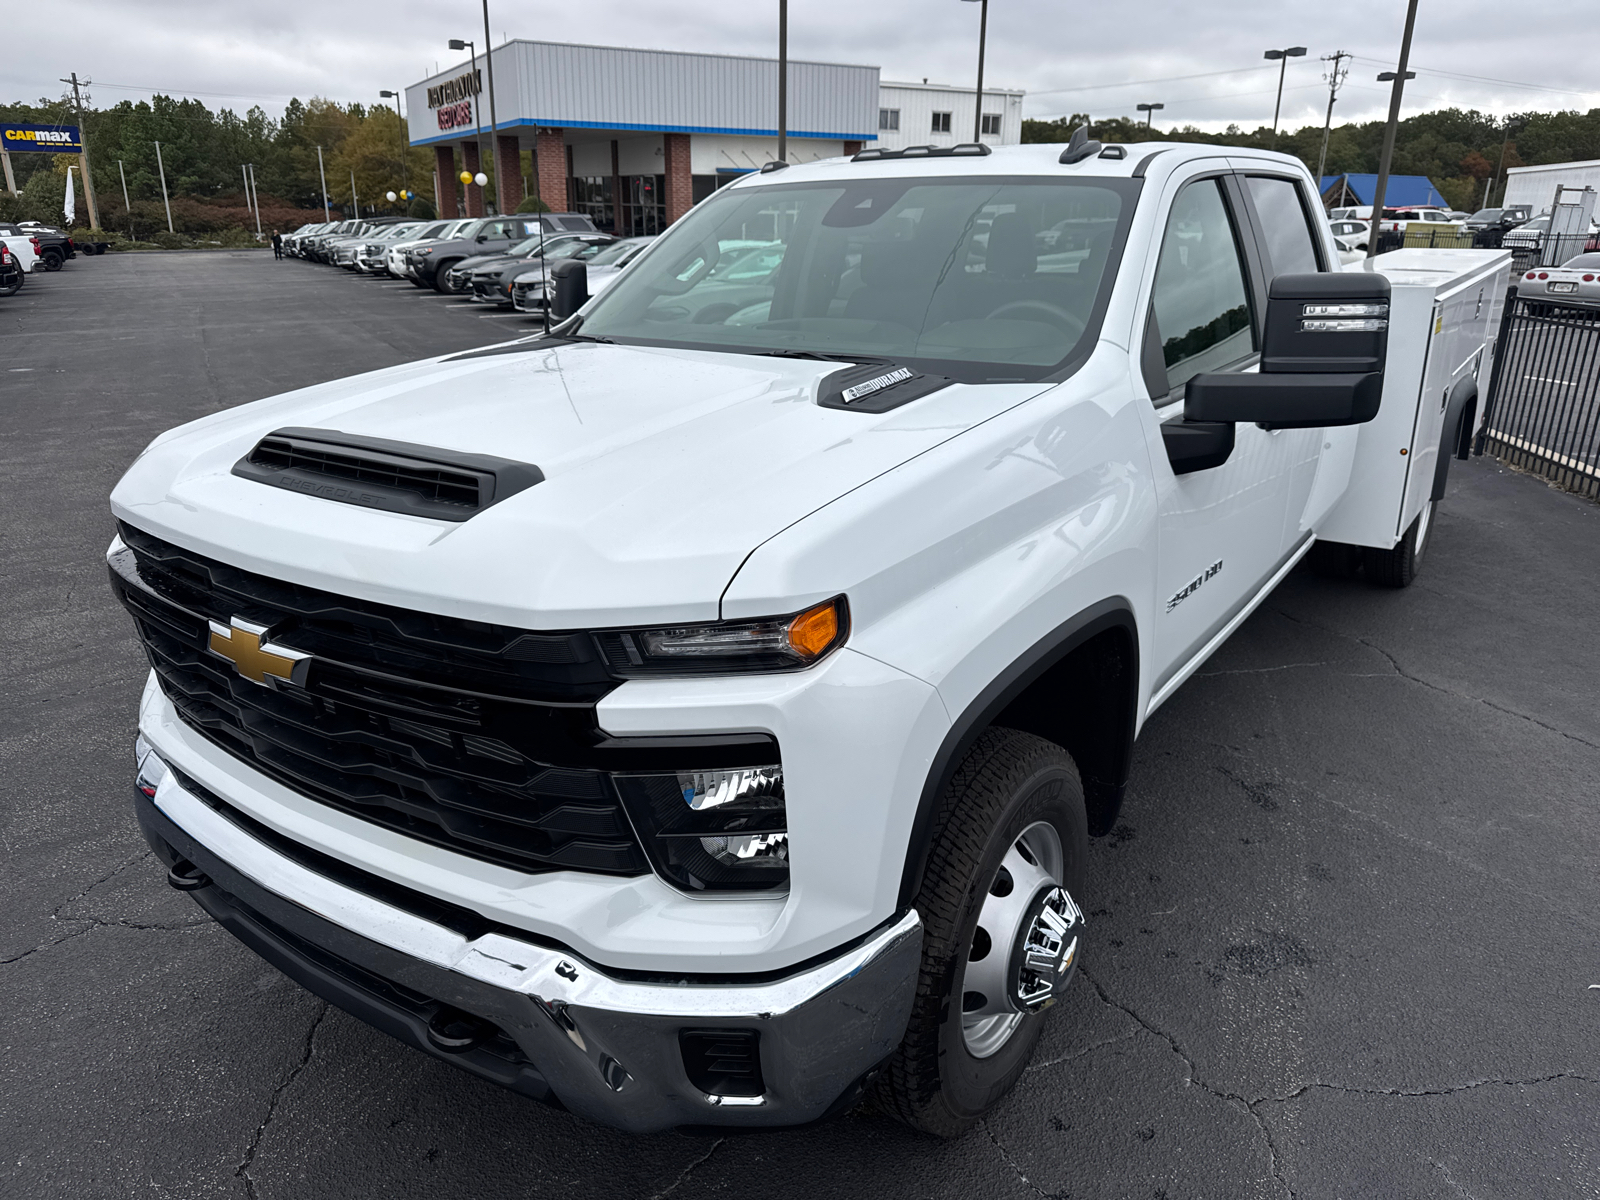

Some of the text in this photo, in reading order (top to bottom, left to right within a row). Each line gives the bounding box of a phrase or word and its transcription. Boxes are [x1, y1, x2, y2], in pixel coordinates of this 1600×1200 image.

[872, 367, 913, 390] DURAMAX
[279, 475, 386, 505] CHEVROLET
[1204, 558, 1223, 582] HD
